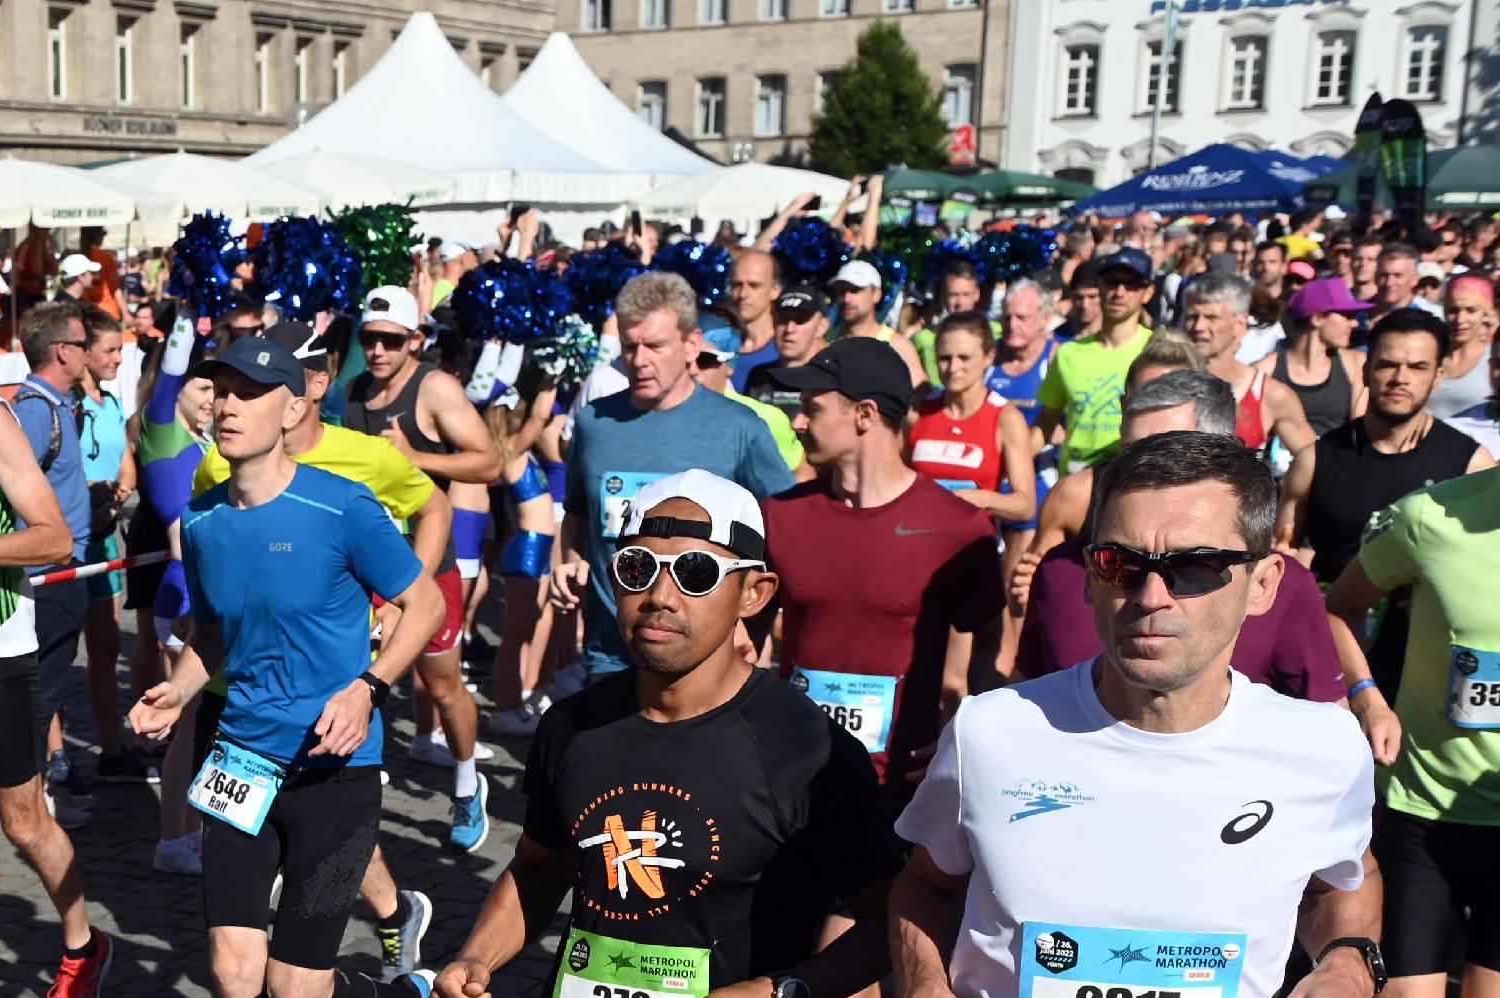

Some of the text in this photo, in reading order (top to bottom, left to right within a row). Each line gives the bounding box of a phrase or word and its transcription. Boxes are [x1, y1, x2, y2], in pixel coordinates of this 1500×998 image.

[269, 542, 293, 552] GORE
[204, 769, 250, 804] 2648
[633, 782, 692, 801] RUNNERS
[1001, 789, 1095, 801] jungfrau marathon
[208, 795, 228, 813] Ralf
[706, 818, 720, 862] SINCE
[604, 910, 639, 920] PACES
[648, 904, 669, 917] ALL
[1055, 949, 1074, 957] 2022
[1156, 945, 1222, 957] METROPO
[640, 955, 697, 968] METROPOL
[1155, 958, 1228, 969] MARATHON
[640, 966, 697, 979] MARATHON
